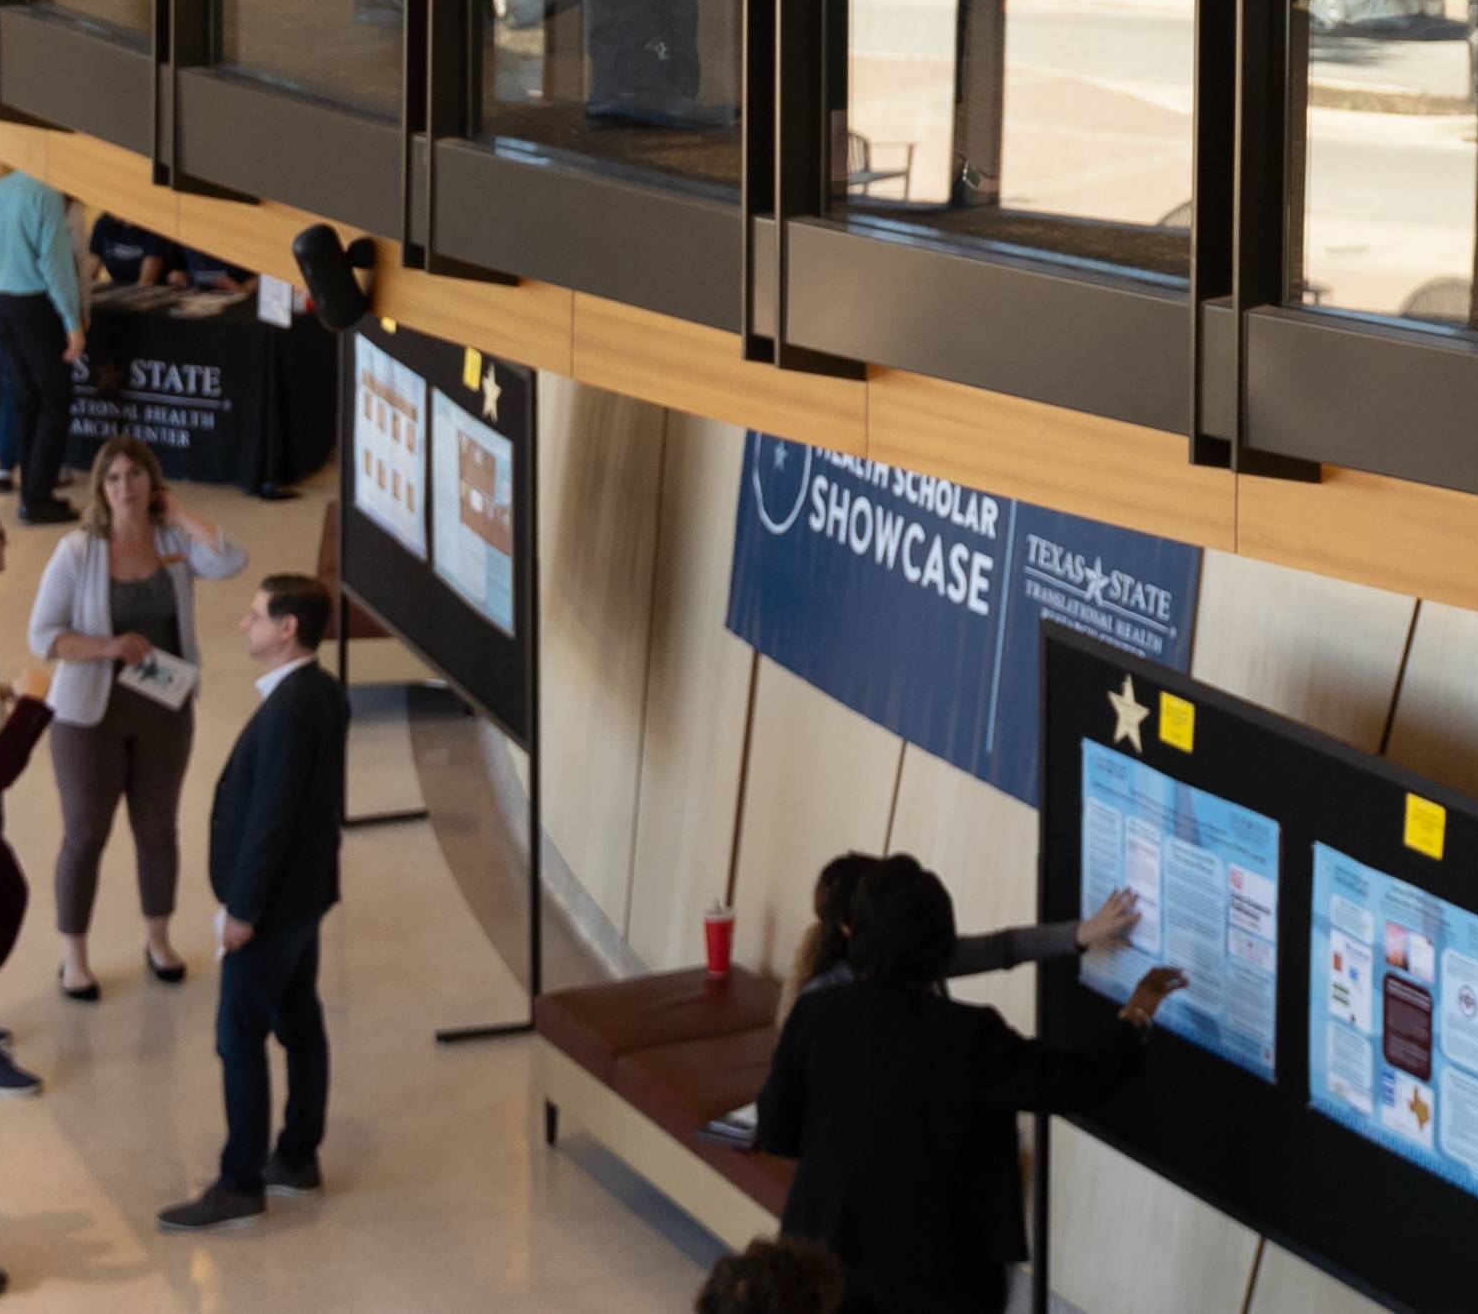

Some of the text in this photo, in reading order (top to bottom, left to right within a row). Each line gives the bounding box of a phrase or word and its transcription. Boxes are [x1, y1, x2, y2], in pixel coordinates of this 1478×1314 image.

[128, 357, 222, 399] STATE
[124, 423, 191, 449] CENTER
[143, 406, 216, 431] HEALTH
[891, 465, 998, 541] SCHOLAR
[808, 474, 995, 617] SHOWCASE
[1026, 533, 1173, 622] TEXAS STATE
[1025, 577, 1114, 637] TRANSLATIONAL
[1114, 619, 1163, 655] HEALTH
